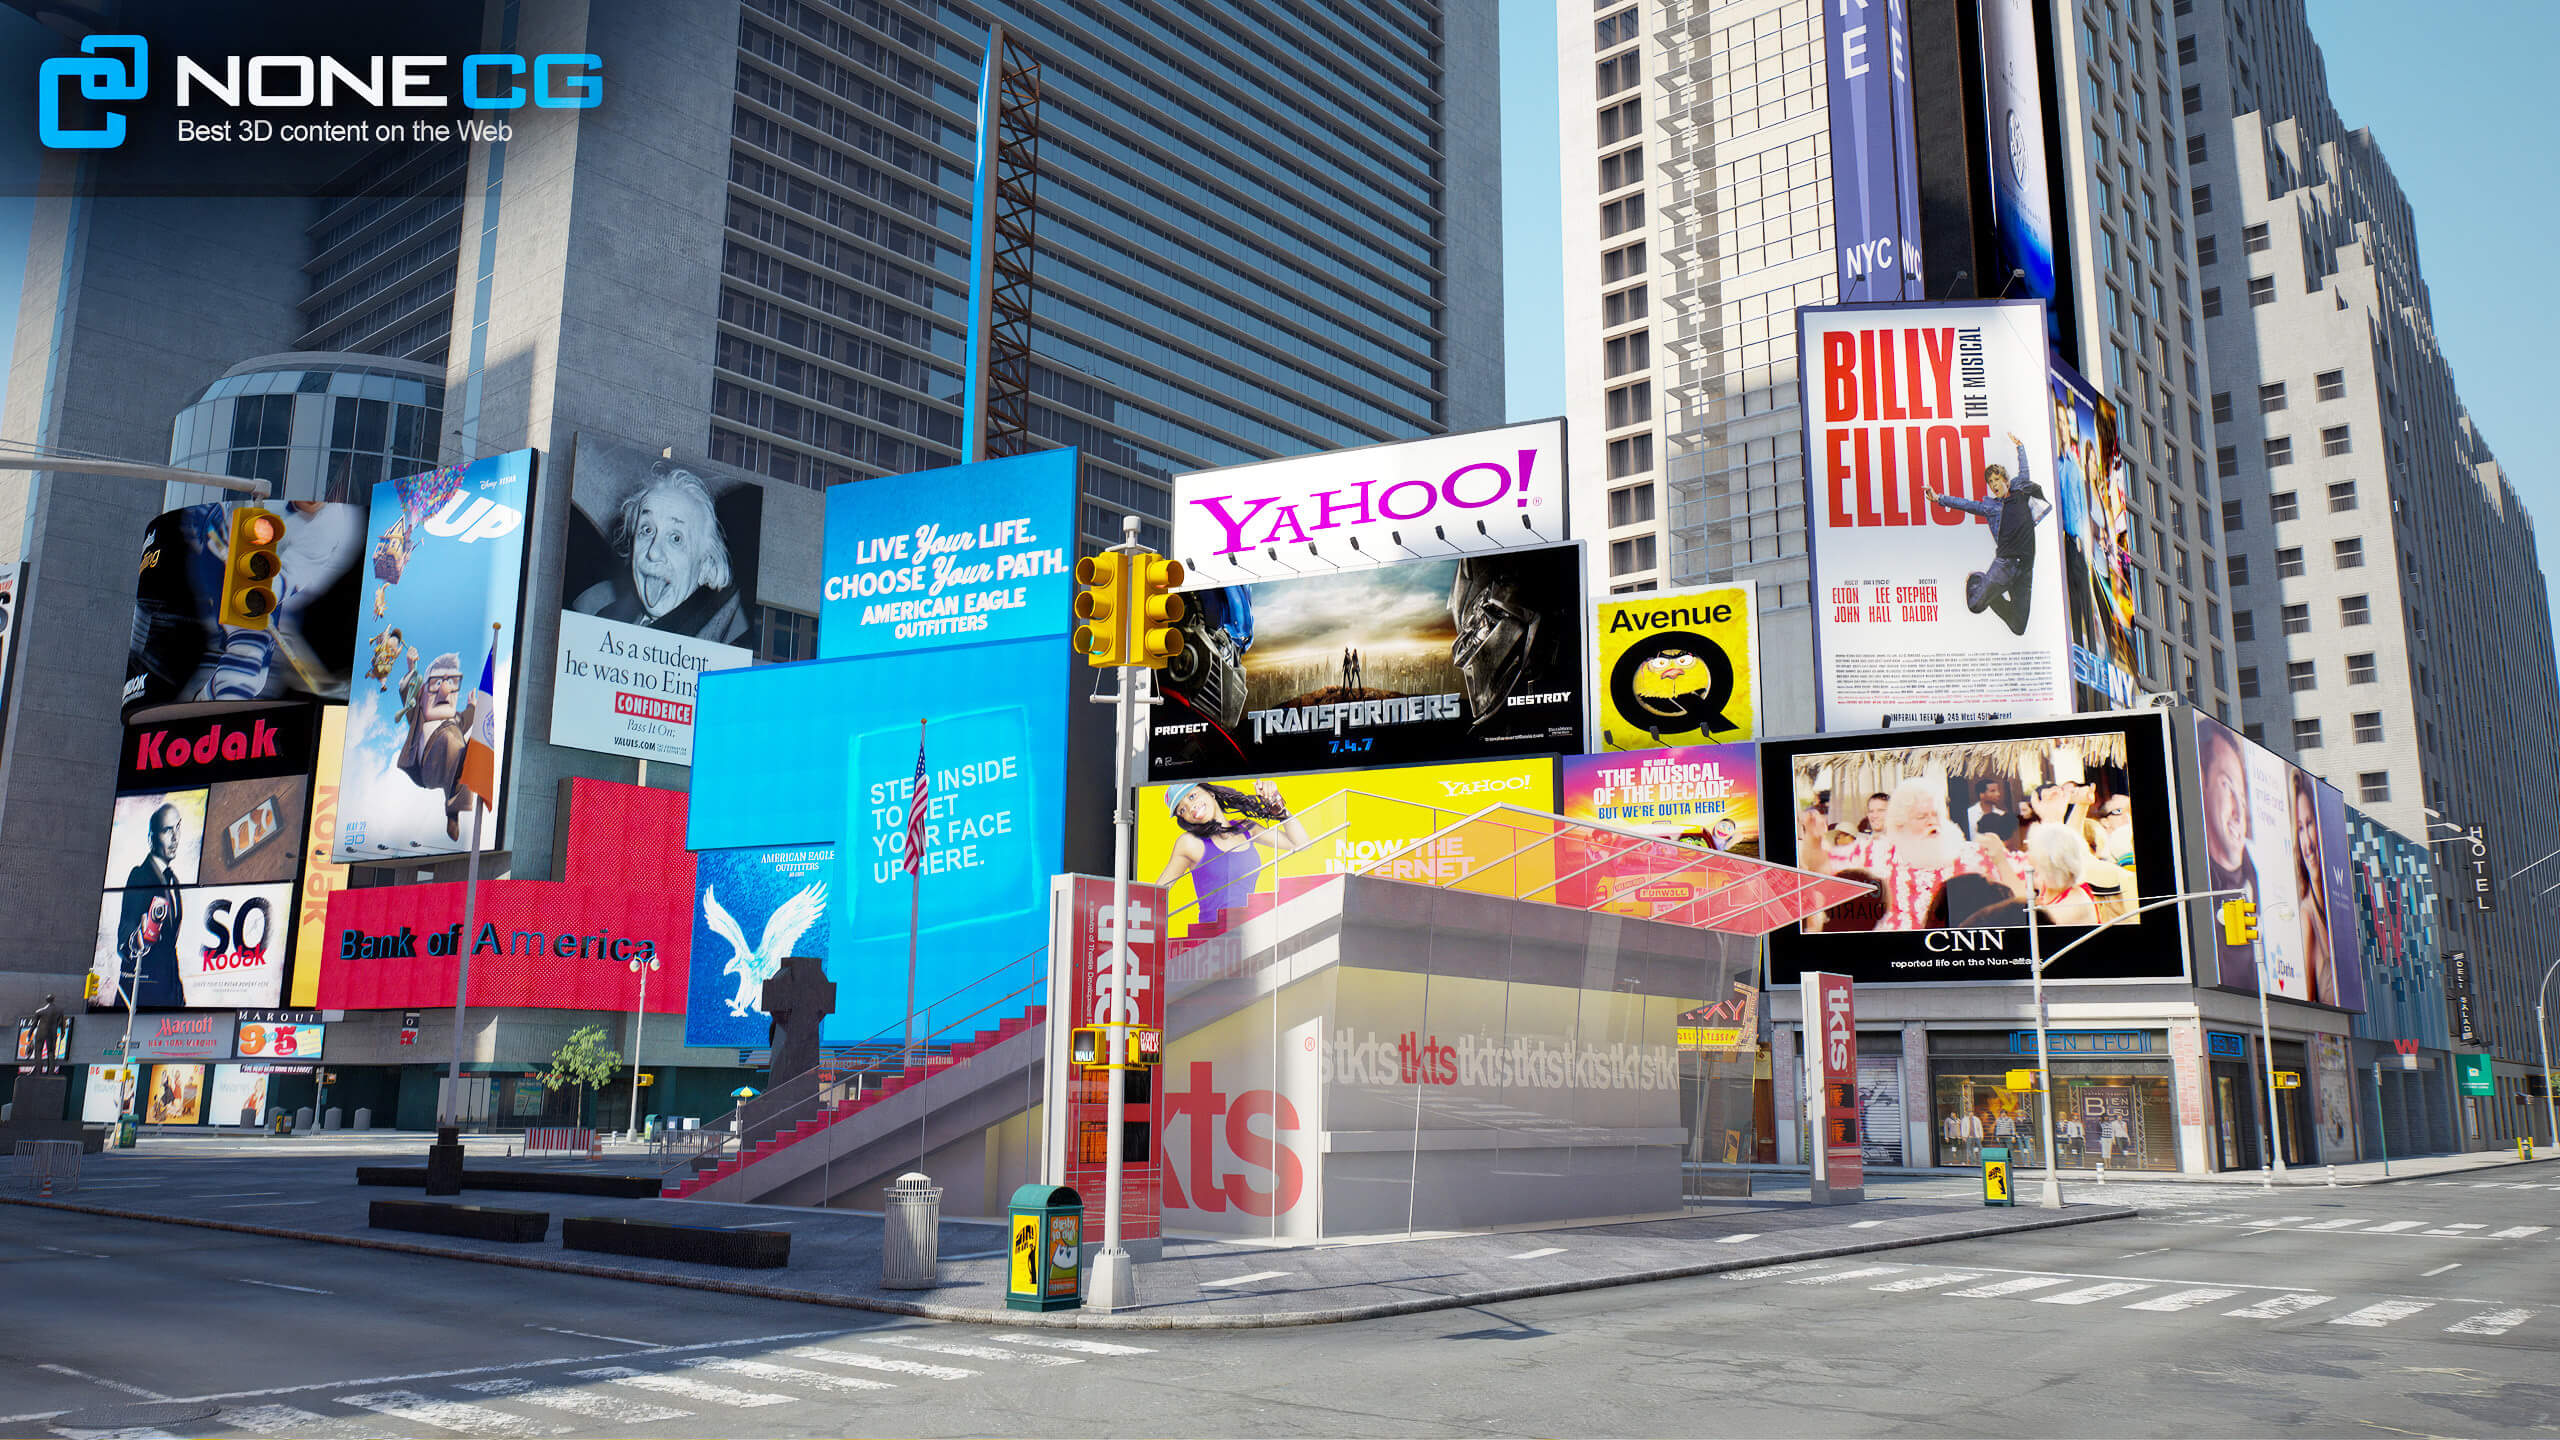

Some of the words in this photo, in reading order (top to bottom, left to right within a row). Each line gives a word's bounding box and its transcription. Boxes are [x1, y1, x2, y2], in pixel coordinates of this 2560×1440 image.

[1846, 236, 1893, 279] NYC
[1901, 235, 1921, 282] NYC
[1958, 325, 1986, 390] MUSICAL
[1823, 327, 1955, 423] BILLY
[1966, 393, 1989, 420] THE
[1826, 425, 1990, 528] ELLIOT
[1190, 449, 1537, 556] YAHOO!
[856, 534, 910, 565] LIVE
[912, 523, 976, 565] Your
[979, 518, 1037, 549] LIFE.
[824, 566, 926, 601] CHOOSE
[929, 555, 993, 596] Your
[996, 548, 1069, 580] PATH.
[860, 595, 960, 625] AMERICAN
[965, 587, 1027, 612] EAGLE
[1832, 587, 1859, 604] ELTON
[1876, 587, 1890, 604] LEE
[1896, 586, 1938, 604] STEPHEN
[894, 614, 989, 639] OUTFITTERS
[1609, 604, 1732, 633] Avenue
[1834, 606, 1860, 623] JOHN
[1869, 605, 1891, 623] HALL
[1902, 605, 1938, 622] DALDRY
[600, 630, 624, 657] As
[628, 645, 639, 659] a
[563, 650, 588, 677] he
[594, 663, 629, 685] was
[633, 672, 657, 690] no
[1610, 631, 1740, 735] Q
[618, 695, 690, 723] CONFIDENCE
[1507, 691, 1571, 706] DESTROY
[627, 719, 646, 734] Pass
[648, 722, 655, 734] It
[1154, 722, 1208, 736] PROTECT
[1248, 692, 1461, 744] TRANSFORMERS
[136, 719, 279, 771] Kodak
[1328, 737, 1374, 754] 7.4.7
[871, 774, 930, 805] STE
[938, 756, 1018, 792] INSIDE
[1437, 775, 1532, 797] YAHOO!
[1640, 762, 1724, 785] MUSICAL
[1593, 787, 1616, 806] OF
[1620, 785, 1655, 804] THE
[1598, 807, 1618, 820] BUT
[1622, 804, 1655, 818] WE'RE
[1659, 802, 1691, 816] OUTTA
[1695, 800, 1725, 814] HERE!
[872, 806, 903, 831] TO
[872, 825, 941, 857] YOR
[948, 810, 1012, 843] FACE
[1335, 838, 1403, 859] NOW
[1409, 836, 1464, 858] THE
[303, 785, 339, 927] Kodak
[761, 851, 806, 863] AMERICAN
[808, 850, 835, 861] EAGLE
[1325, 856, 1476, 879] INTERNET
[2469, 826, 2490, 910] HOTEL
[874, 858, 904, 884] UP
[200, 896, 272, 958] SO
[1924, 929, 2005, 952] CNN
[340, 926, 417, 960] Bank
[427, 923, 463, 957] of
[472, 922, 656, 962] America
[203, 943, 266, 972] Kodak
[1891, 959, 1932, 969] reported
[1968, 958, 1985, 967] the
[155, 1015, 213, 1038] Marriott
[239, 1025, 266, 1055] 9
[274, 1026, 298, 1056] 5
[1828, 986, 1849, 1071] tkts
[1075, 1050, 1095, 1063] WALK
[1398, 1031, 1458, 1086] tkts
